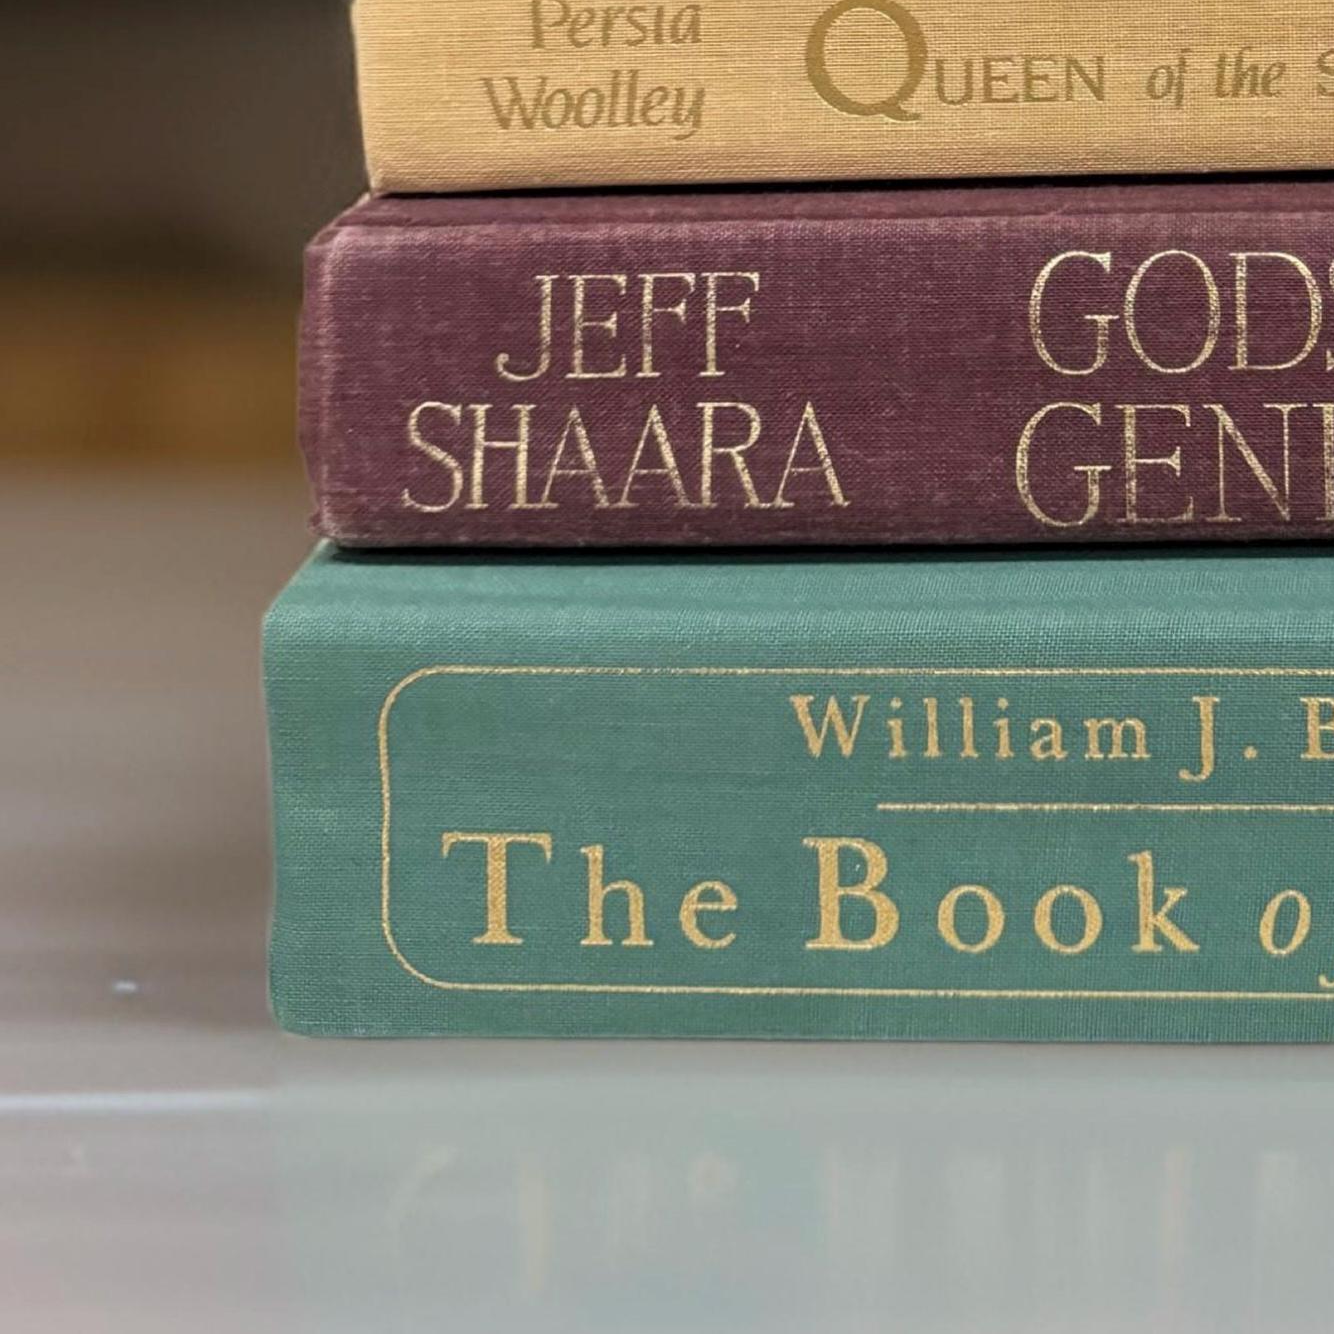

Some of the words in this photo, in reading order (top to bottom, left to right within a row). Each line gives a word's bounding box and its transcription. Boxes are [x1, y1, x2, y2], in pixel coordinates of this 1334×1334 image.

[482, 69, 706, 140] Woolley
[1146, 54, 1192, 107] of
[1214, 46, 1284, 96] the
[495, 270, 761, 383] JEFF
[401, 400, 851, 514] SHAARA
[788, 694, 1152, 760] William
[1179, 694, 1259, 782] J.
[441, 830, 739, 950] The
[802, 836, 1201, 955] Book
